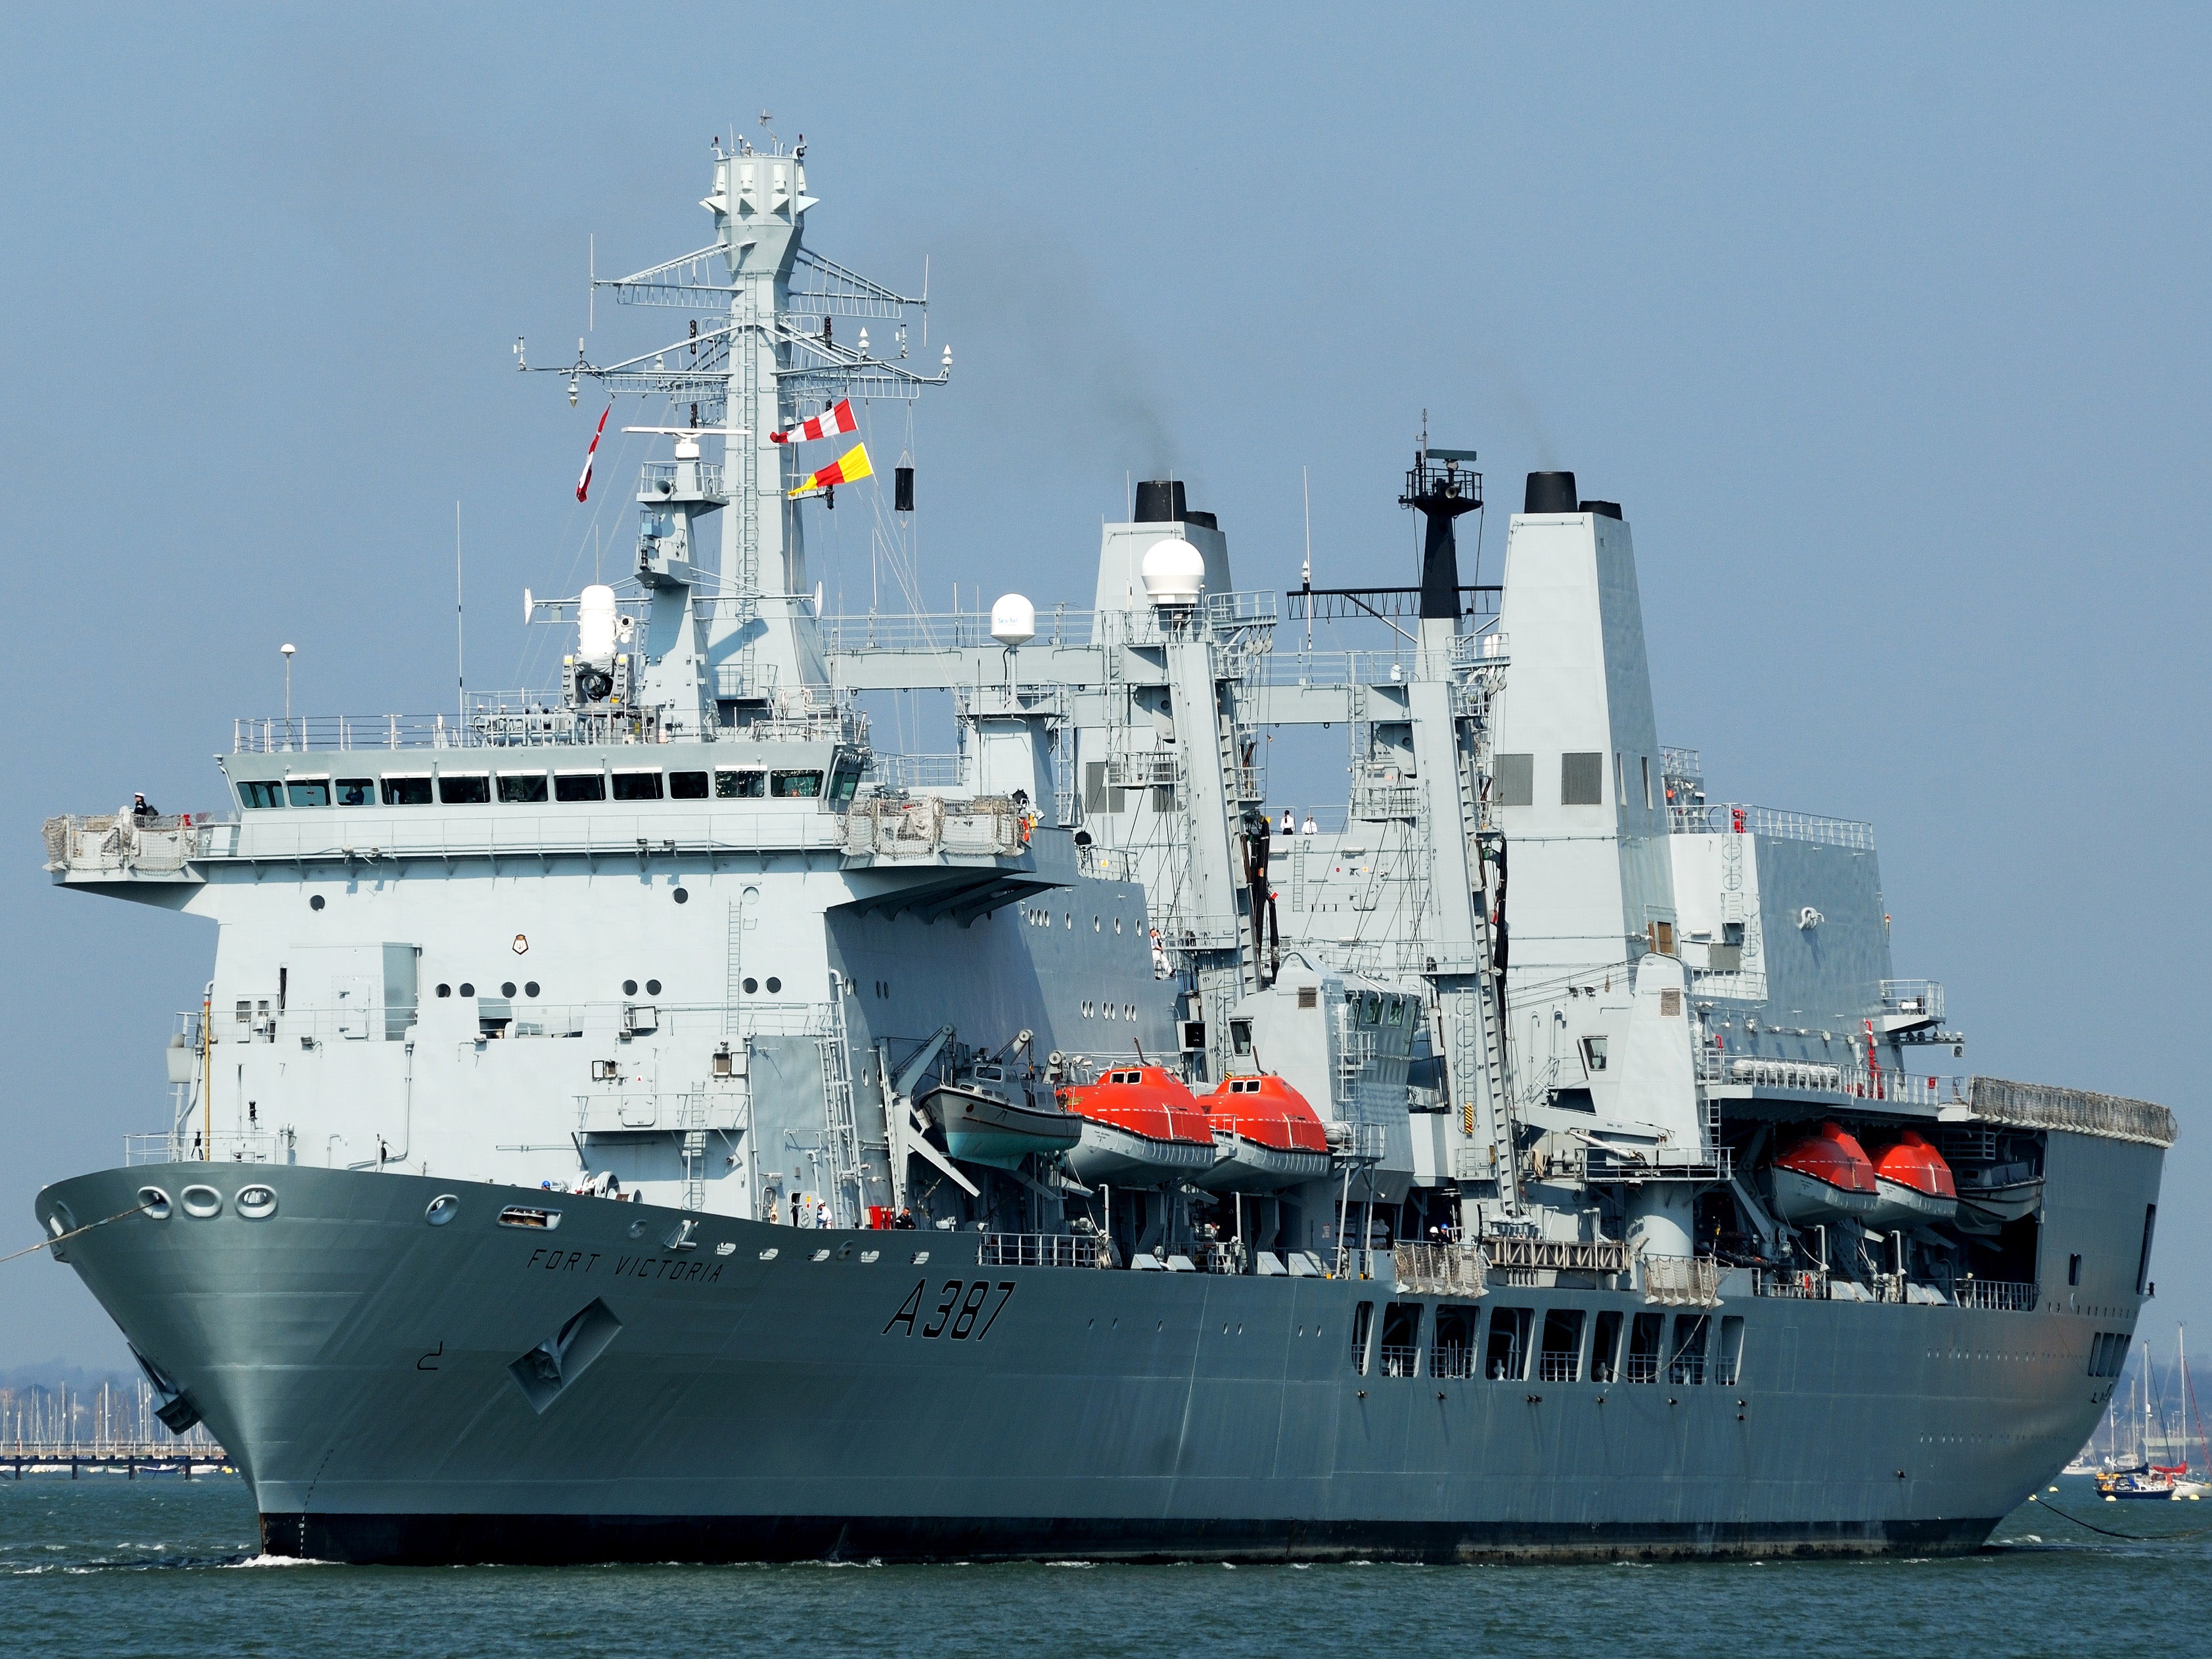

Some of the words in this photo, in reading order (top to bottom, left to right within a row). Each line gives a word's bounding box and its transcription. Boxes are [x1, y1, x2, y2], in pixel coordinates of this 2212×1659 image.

[527, 1249, 600, 1272] FORT
[615, 1256, 723, 1283] VICTORIA
[880, 1278, 1016, 1341] A387
